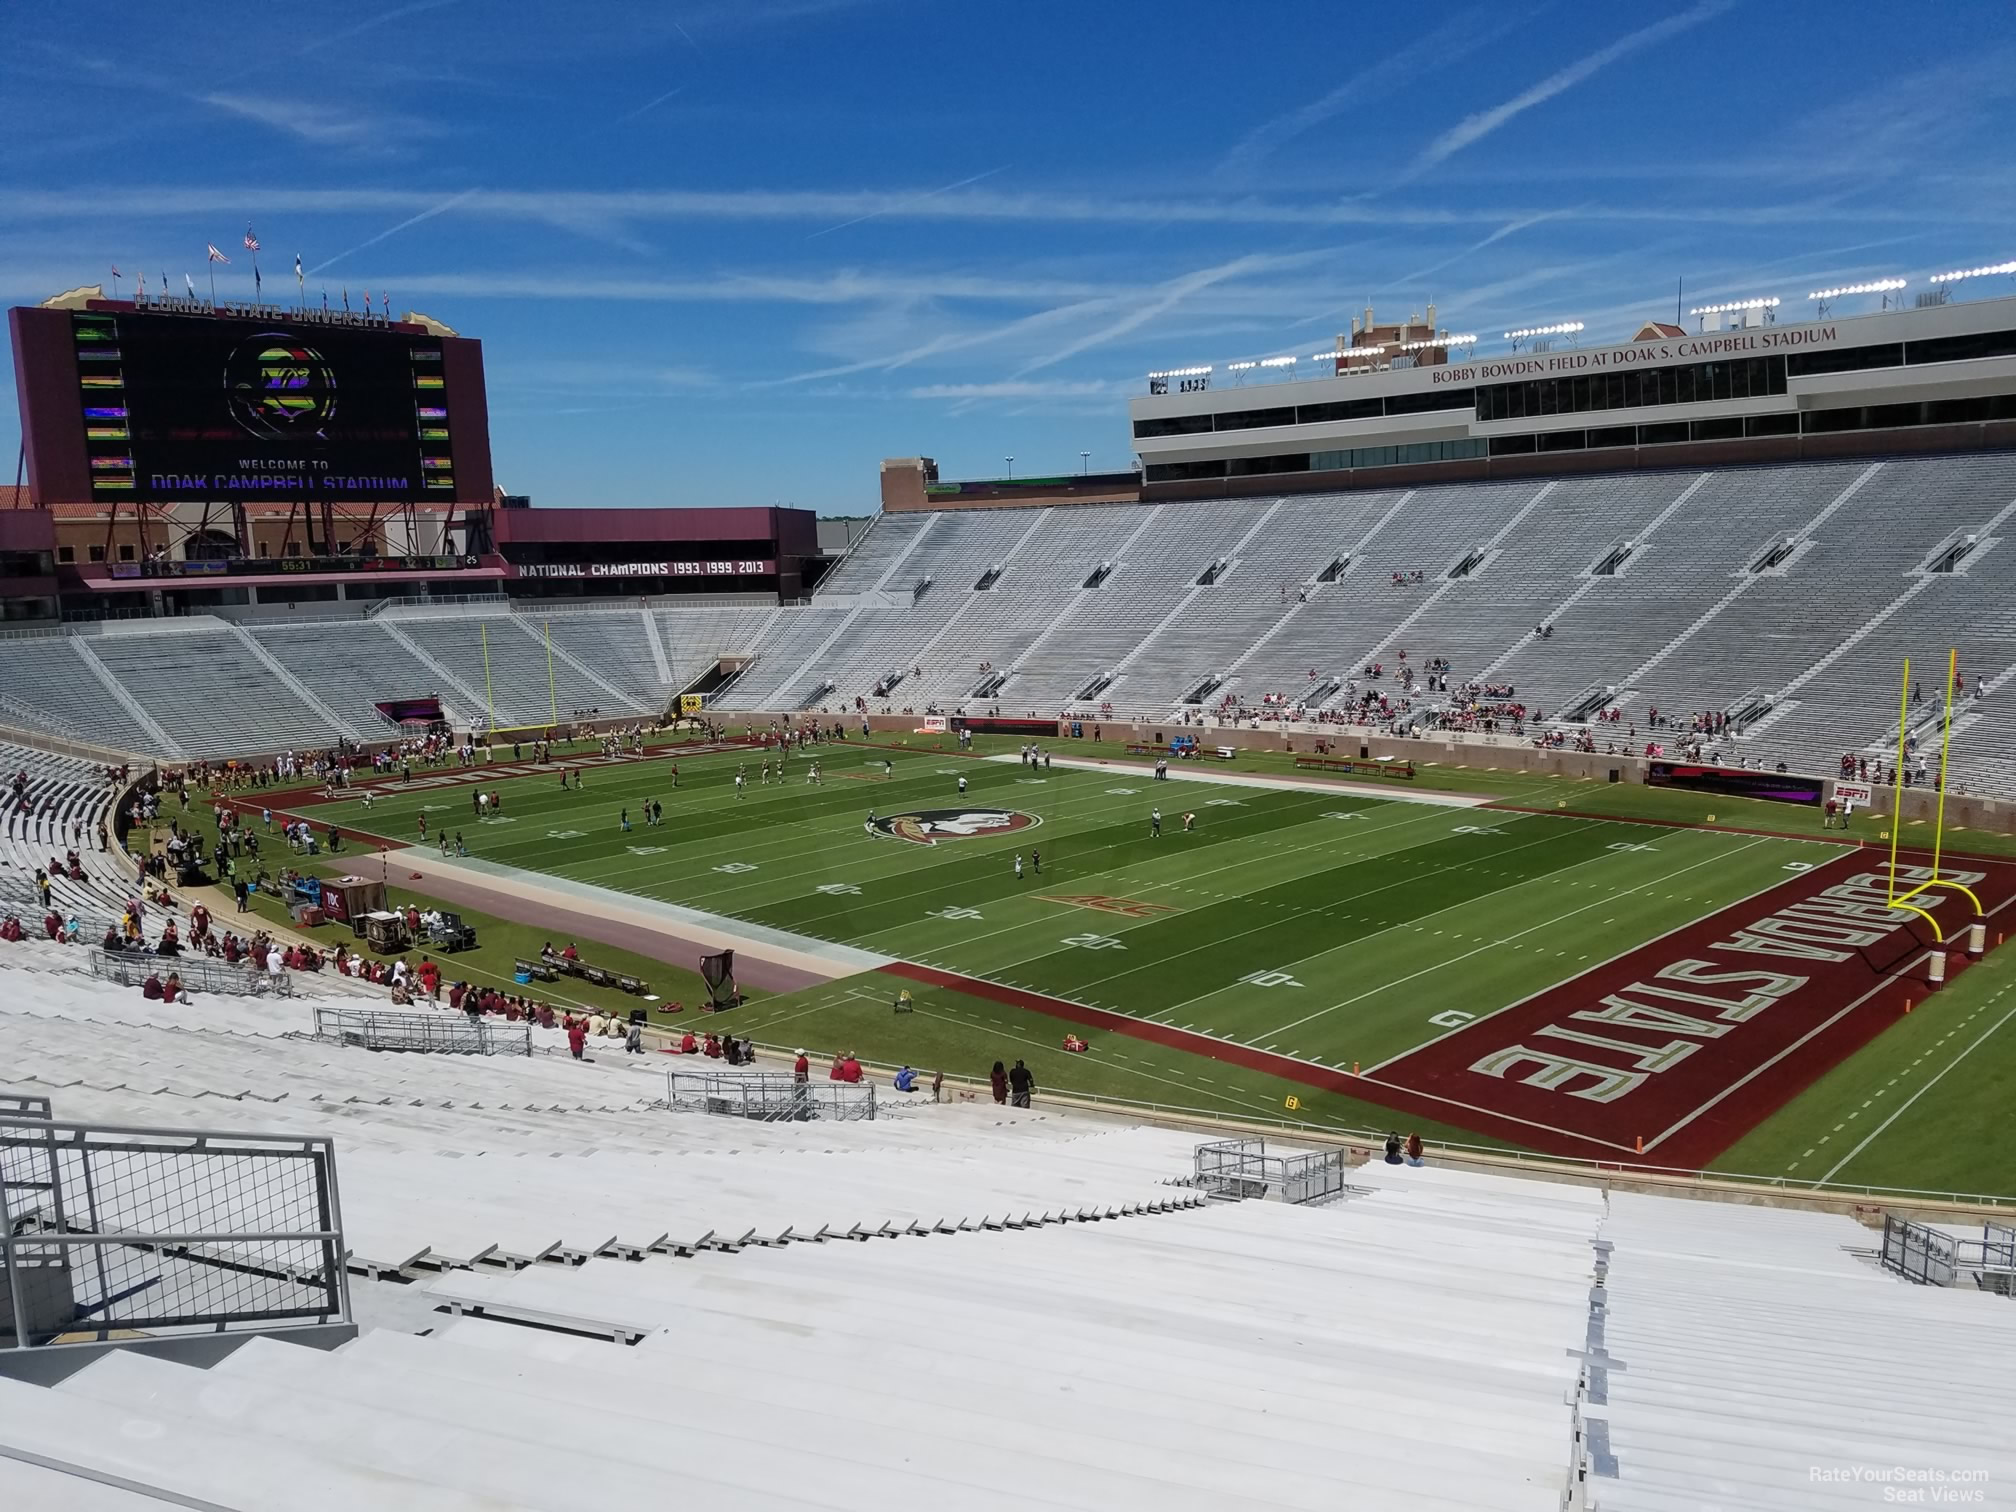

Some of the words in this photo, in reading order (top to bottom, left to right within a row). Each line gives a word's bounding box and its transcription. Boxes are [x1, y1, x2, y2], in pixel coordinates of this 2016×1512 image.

[134, 294, 216, 315] FLORIDA
[224, 301, 283, 320] STATE
[290, 306, 390, 329] UNIVERSITY
[1432, 367, 1478, 384] BOBBY
[1481, 360, 1545, 380] BOWDEN
[1549, 356, 1587, 371] FIELD
[1590, 353, 1607, 367] AT
[1612, 347, 1657, 364] DOAK
[1661, 345, 1673, 359] S.
[1677, 336, 1757, 357] CAMPBELL
[1762, 327, 1837, 347] STADIUM
[239, 459, 306, 470] WELCOME
[312, 460, 328, 470] TO
[151, 474, 207, 489] DOAK
[281, 560, 311, 571] 55:31
[466, 555, 477, 564] 25
[519, 564, 585, 577] NATIONAL
[591, 563, 668, 576] CHAMPIONS
[674, 562, 703, 576] 1993,
[707, 561, 735, 575] 1999,
[739, 561, 764, 573] 2013
[1835, 786, 1869, 799] ESPN
[1708, 861, 1987, 964] FLORIDA
[1059, 933, 1122, 950] 20
[1237, 969, 1294, 987] 10
[1428, 1009, 1475, 1028] G
[1467, 959, 1811, 1104] STATE
